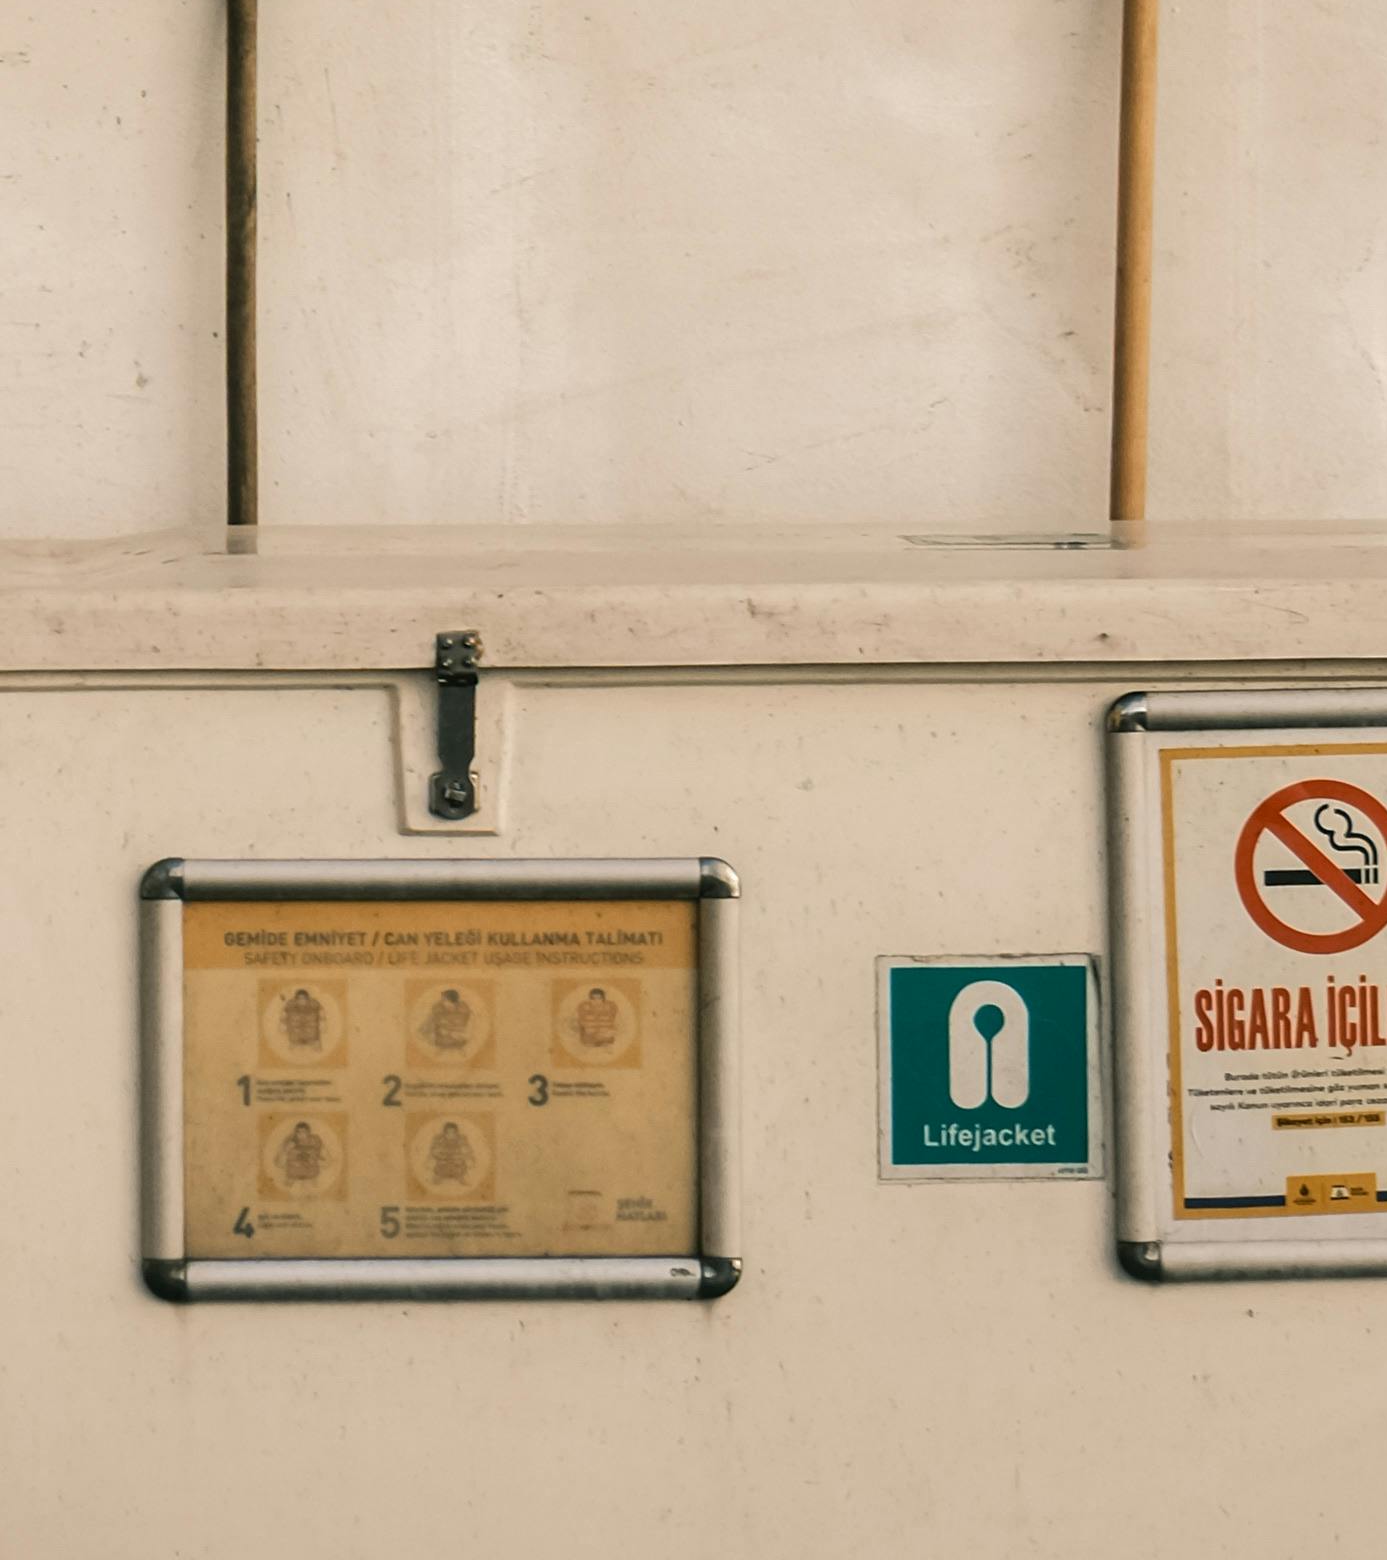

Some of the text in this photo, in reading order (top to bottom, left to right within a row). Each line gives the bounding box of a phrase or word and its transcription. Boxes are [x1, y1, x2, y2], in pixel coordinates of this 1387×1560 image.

[1195, 979, 1319, 1052] SİGARA
[237, 1075, 251, 1106] 1
[382, 1074, 402, 1106] 2
[528, 1074, 549, 1106] 3
[924, 1123, 1056, 1152] Lifejacket
[233, 1207, 255, 1238] 4
[380, 1206, 400, 1238] 5
